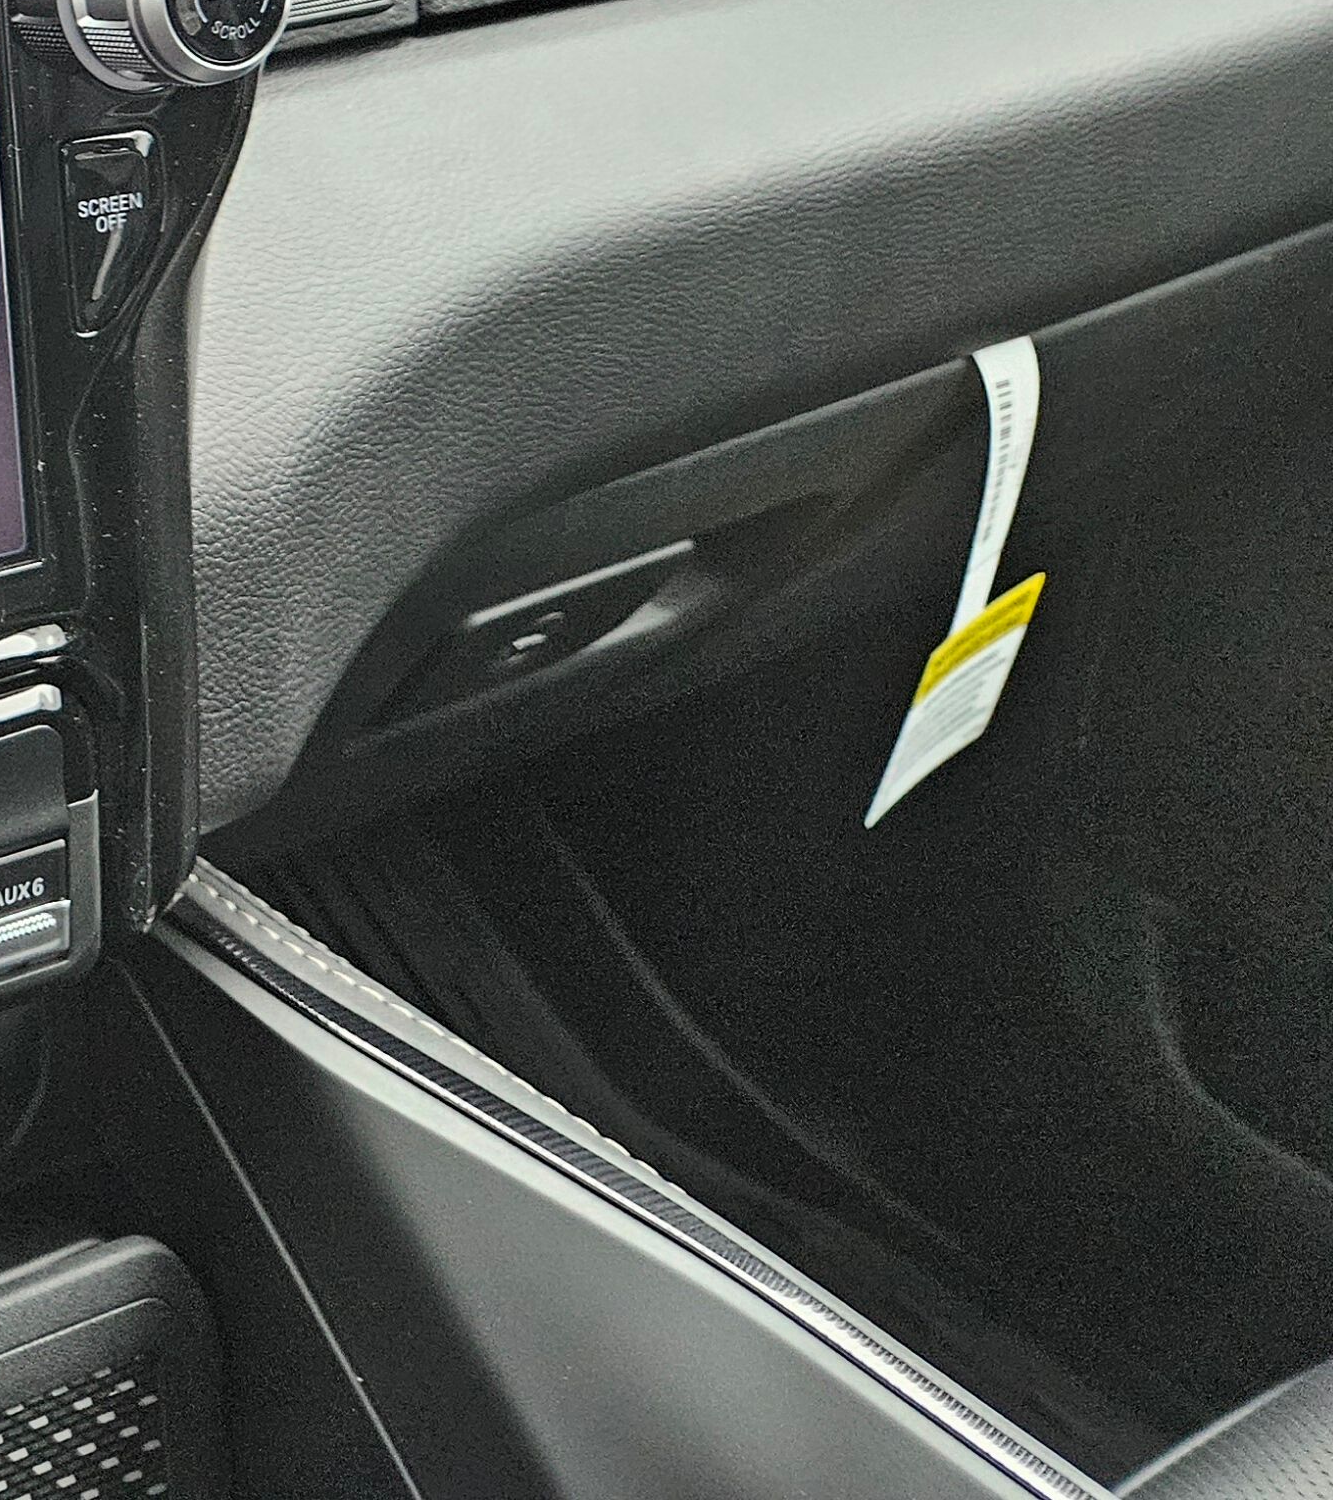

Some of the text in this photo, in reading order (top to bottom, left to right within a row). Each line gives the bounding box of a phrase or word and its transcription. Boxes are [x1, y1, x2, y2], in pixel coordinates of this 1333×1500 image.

[211, 16, 261, 40] SCROLL
[77, 192, 144, 218] SCREEN
[95, 213, 128, 233] OFF
[31, 877, 45, 897] 6
